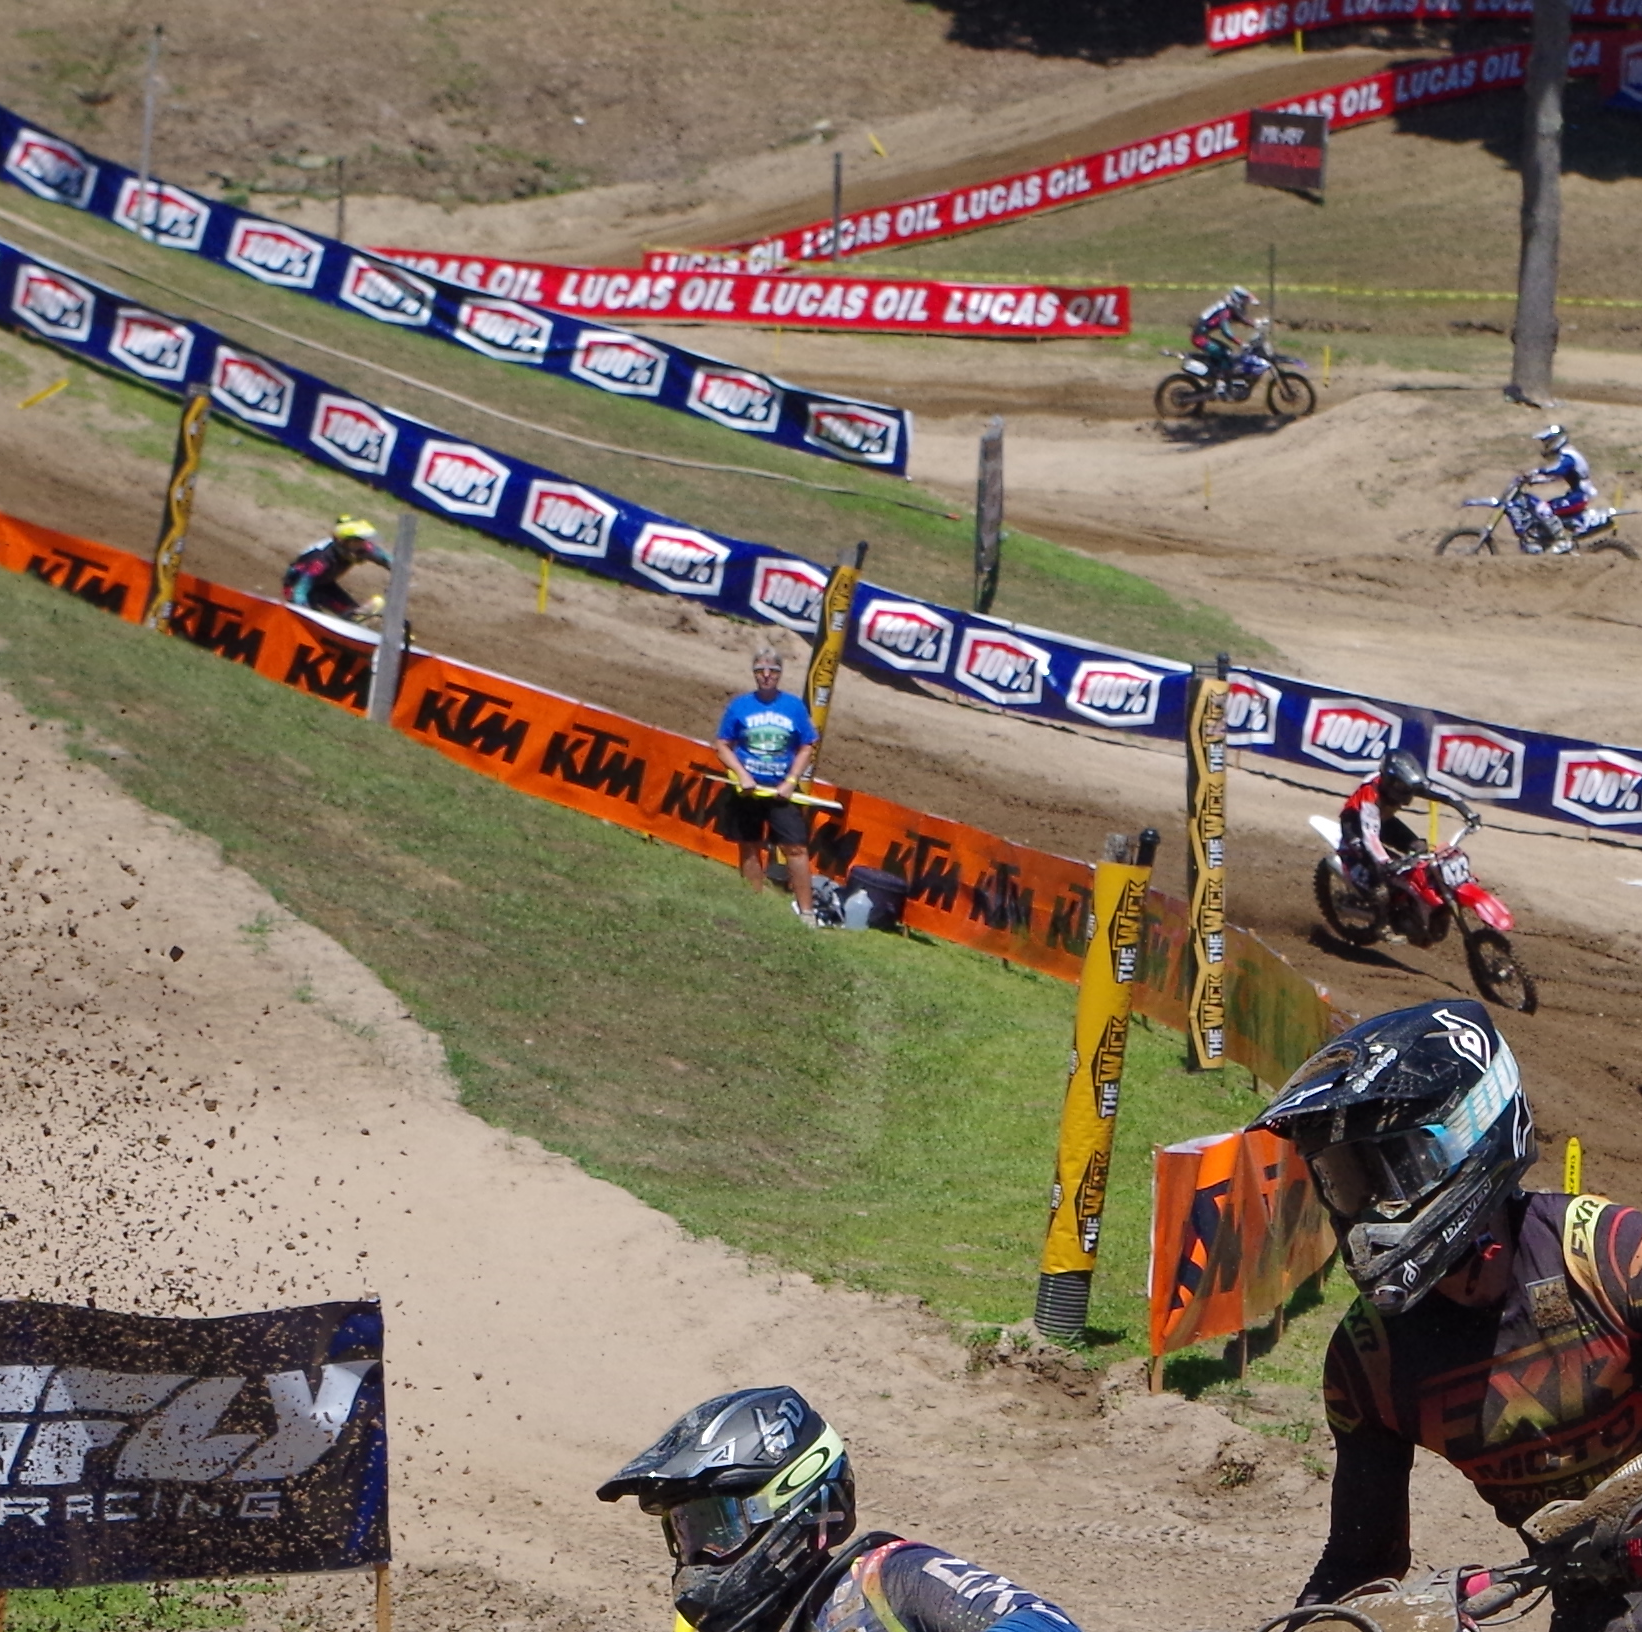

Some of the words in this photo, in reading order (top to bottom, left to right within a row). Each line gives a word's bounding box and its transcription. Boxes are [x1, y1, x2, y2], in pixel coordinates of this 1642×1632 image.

[1211, 5, 1285, 42] LUCAS
[1394, 60, 1478, 103] LUCAS
[1481, 51, 1524, 81] OIL
[1101, 133, 1192, 183] LUCAS
[1196, 121, 1239, 156] OIL
[954, 174, 1043, 223] LUCAS
[1046, 167, 1091, 200] OIL
[895, 201, 942, 237] OIL
[240, 230, 313, 277] 100%
[557, 273, 676, 311] LUCAS
[678, 277, 737, 312] OIL
[749, 279, 868, 321] LUCAS
[871, 286, 930, 322] OIL
[943, 290, 1061, 327] LUCAS
[1064, 293, 1122, 326] OIL
[585, 344, 656, 384] 100%
[701, 376, 773, 421] 100%
[816, 414, 890, 454] 100%
[427, 458, 494, 504] 100%
[534, 495, 602, 544] 100%
[643, 540, 717, 583] 100%
[166, 589, 266, 669] KTM
[870, 615, 937, 660] 100%
[972, 643, 1035, 692] 100%
[1080, 673, 1150, 713] 100%
[412, 682, 532, 765] KTM
[1316, 711, 1387, 760] 100%
[539, 722, 651, 804] KTM
[1209, 743, 1224, 773] THE
[1444, 738, 1511, 786] 100%
[1204, 782, 1226, 839] WICK
[1569, 766, 1642, 811] 100%
[881, 828, 962, 914] KTM
[1208, 838, 1224, 869] THE
[1116, 880, 1147, 947] WICK
[1204, 879, 1225, 934] WICK
[1117, 947, 1137, 984] THE
[1208, 933, 1223, 964] THE
[1204, 973, 1225, 1029] WICK
[1099, 1015, 1128, 1082] WICK
[1207, 1028, 1223, 1059] THE
[1099, 1082, 1120, 1119] THE
[1570, 1198, 1601, 1259] FXR
[1473, 1399, 1639, 1485] MOTO
